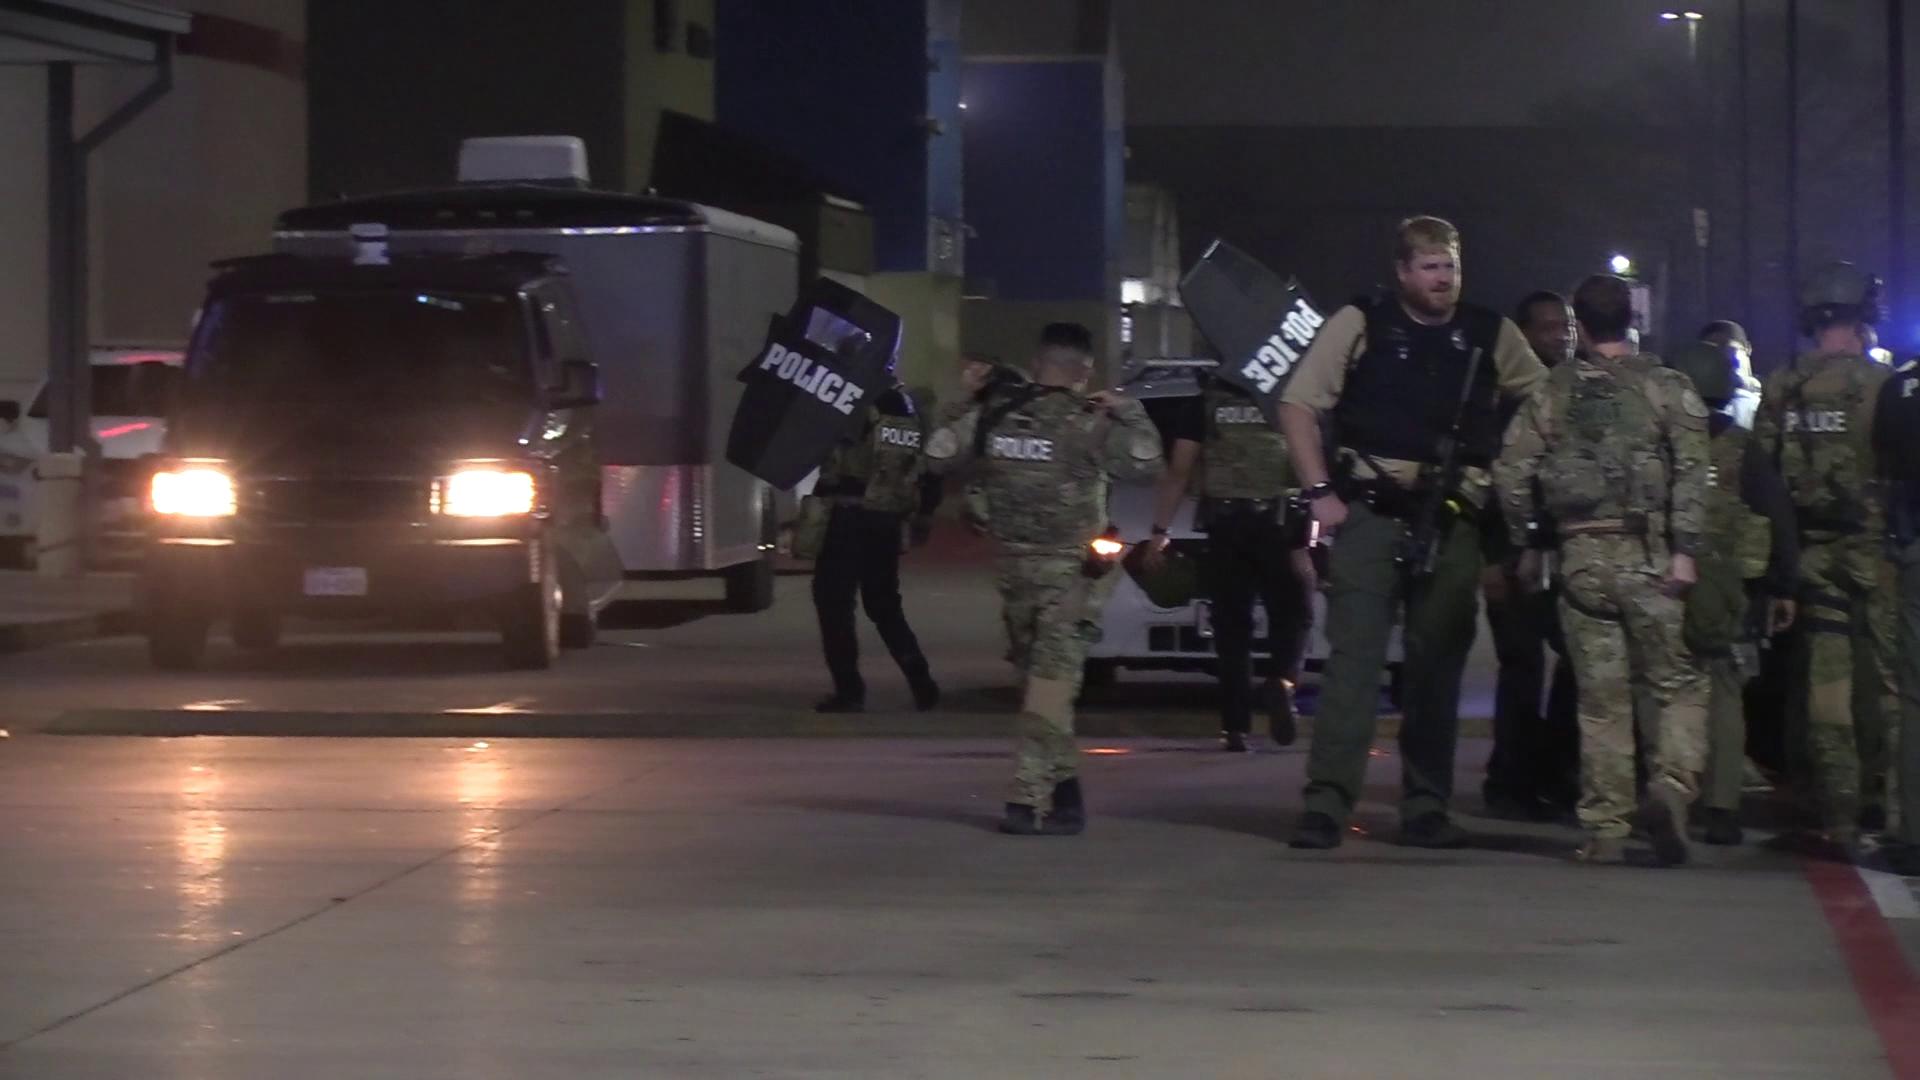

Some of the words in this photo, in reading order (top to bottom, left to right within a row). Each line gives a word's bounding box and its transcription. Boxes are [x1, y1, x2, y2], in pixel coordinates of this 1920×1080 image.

[1241, 299, 1325, 394] POLICE
[759, 343, 865, 415] POLICE
[1785, 410, 1847, 432] PLICE
[881, 427, 921, 449] POLICE
[992, 436, 1053, 462] POLICE
